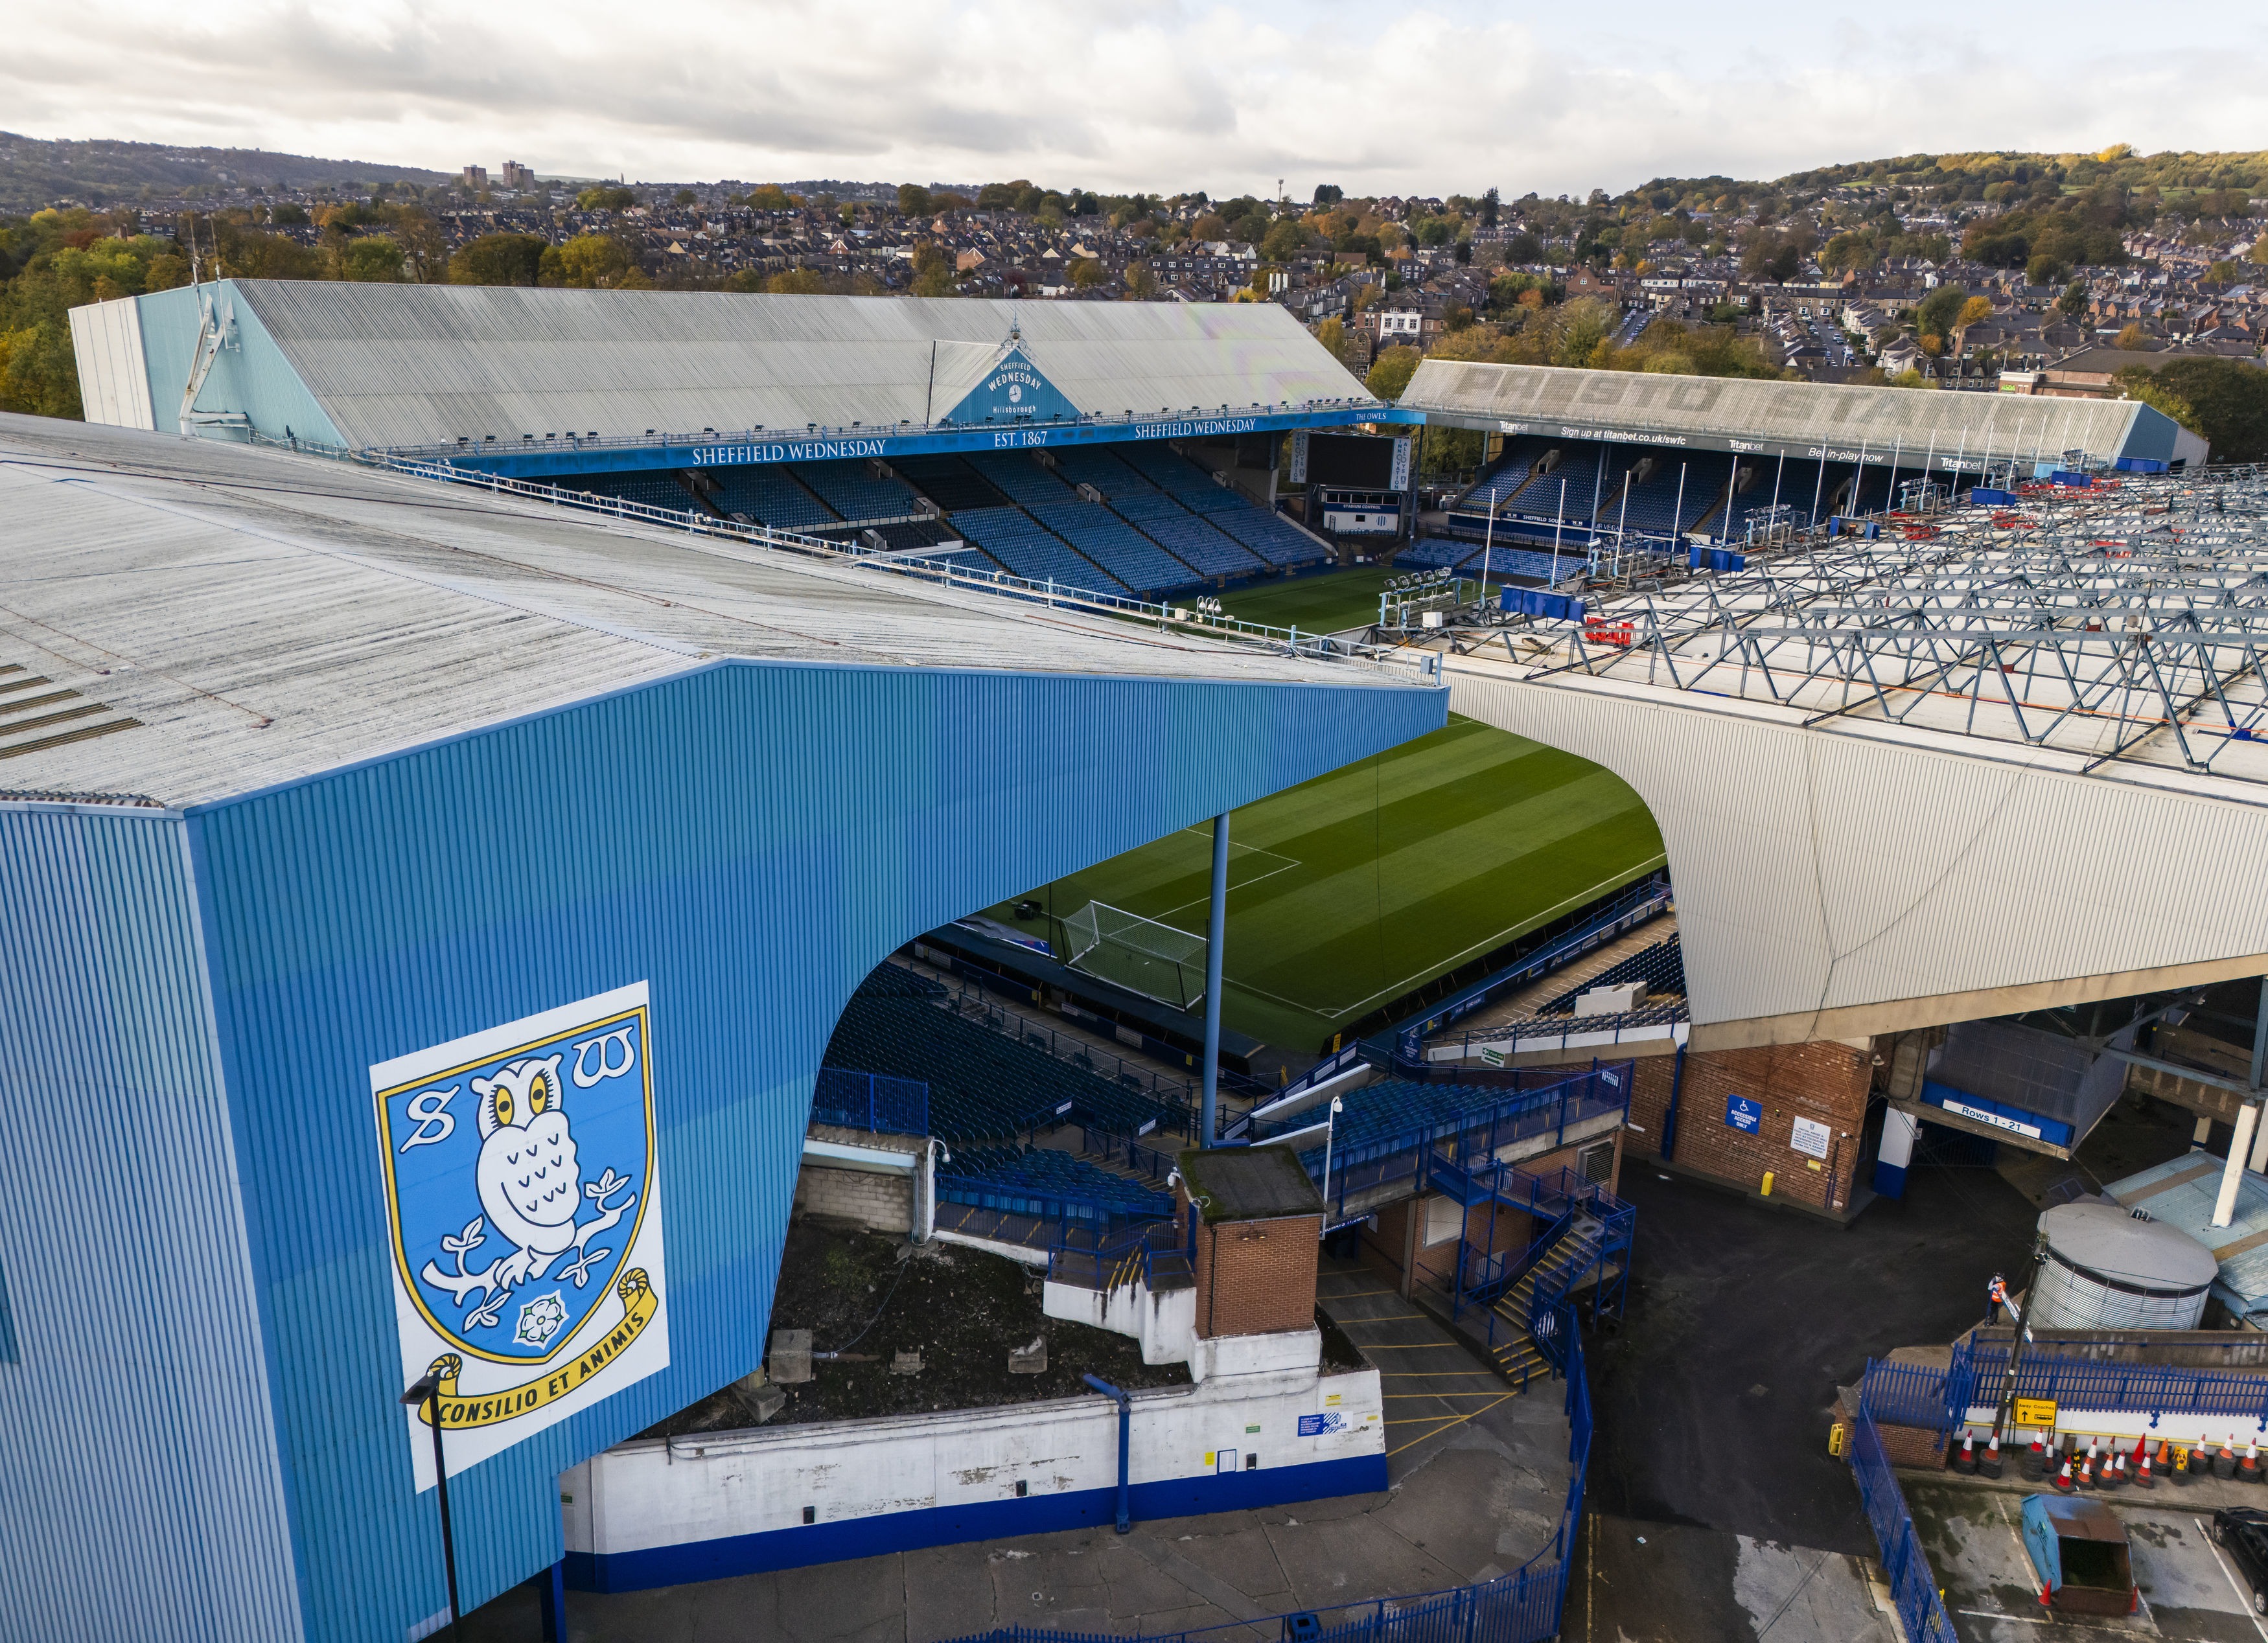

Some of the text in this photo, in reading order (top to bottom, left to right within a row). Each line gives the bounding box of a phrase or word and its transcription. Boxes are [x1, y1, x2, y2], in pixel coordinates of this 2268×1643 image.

[1000, 362, 1030, 372] SHEFFIELD
[988, 372, 1041, 392] WEDNESDAY
[993, 405, 1036, 414] Hillsborough
[1367, 412, 1386, 420] OWLS
[1135, 419, 1256, 439] SHEFFIELD WEDNESDAY
[1499, 420, 1529, 431] Titanbet
[995, 431, 1048, 447] EST. 1867
[1560, 426, 1686, 446] Sign up at titanbet.co.uk/swfc
[693, 439, 886, 465] SHEFFIELD WEDNESDAY
[1729, 439, 1764, 452] Titanbet
[1827, 449, 1860, 462] in-play
[1862, 454, 1884, 463] now
[1940, 457, 1982, 470] Titanbet
[399, 1024, 635, 1154] S W
[1731, 1109, 1757, 1122] ACCESSIBLE
[1734, 1116, 1751, 1125] ACCESS
[1961, 1106, 1989, 1121] Rows
[2009, 1121, 2020, 1131] 21
[439, 1311, 644, 1423] CONSILIO ET ANIMIS
